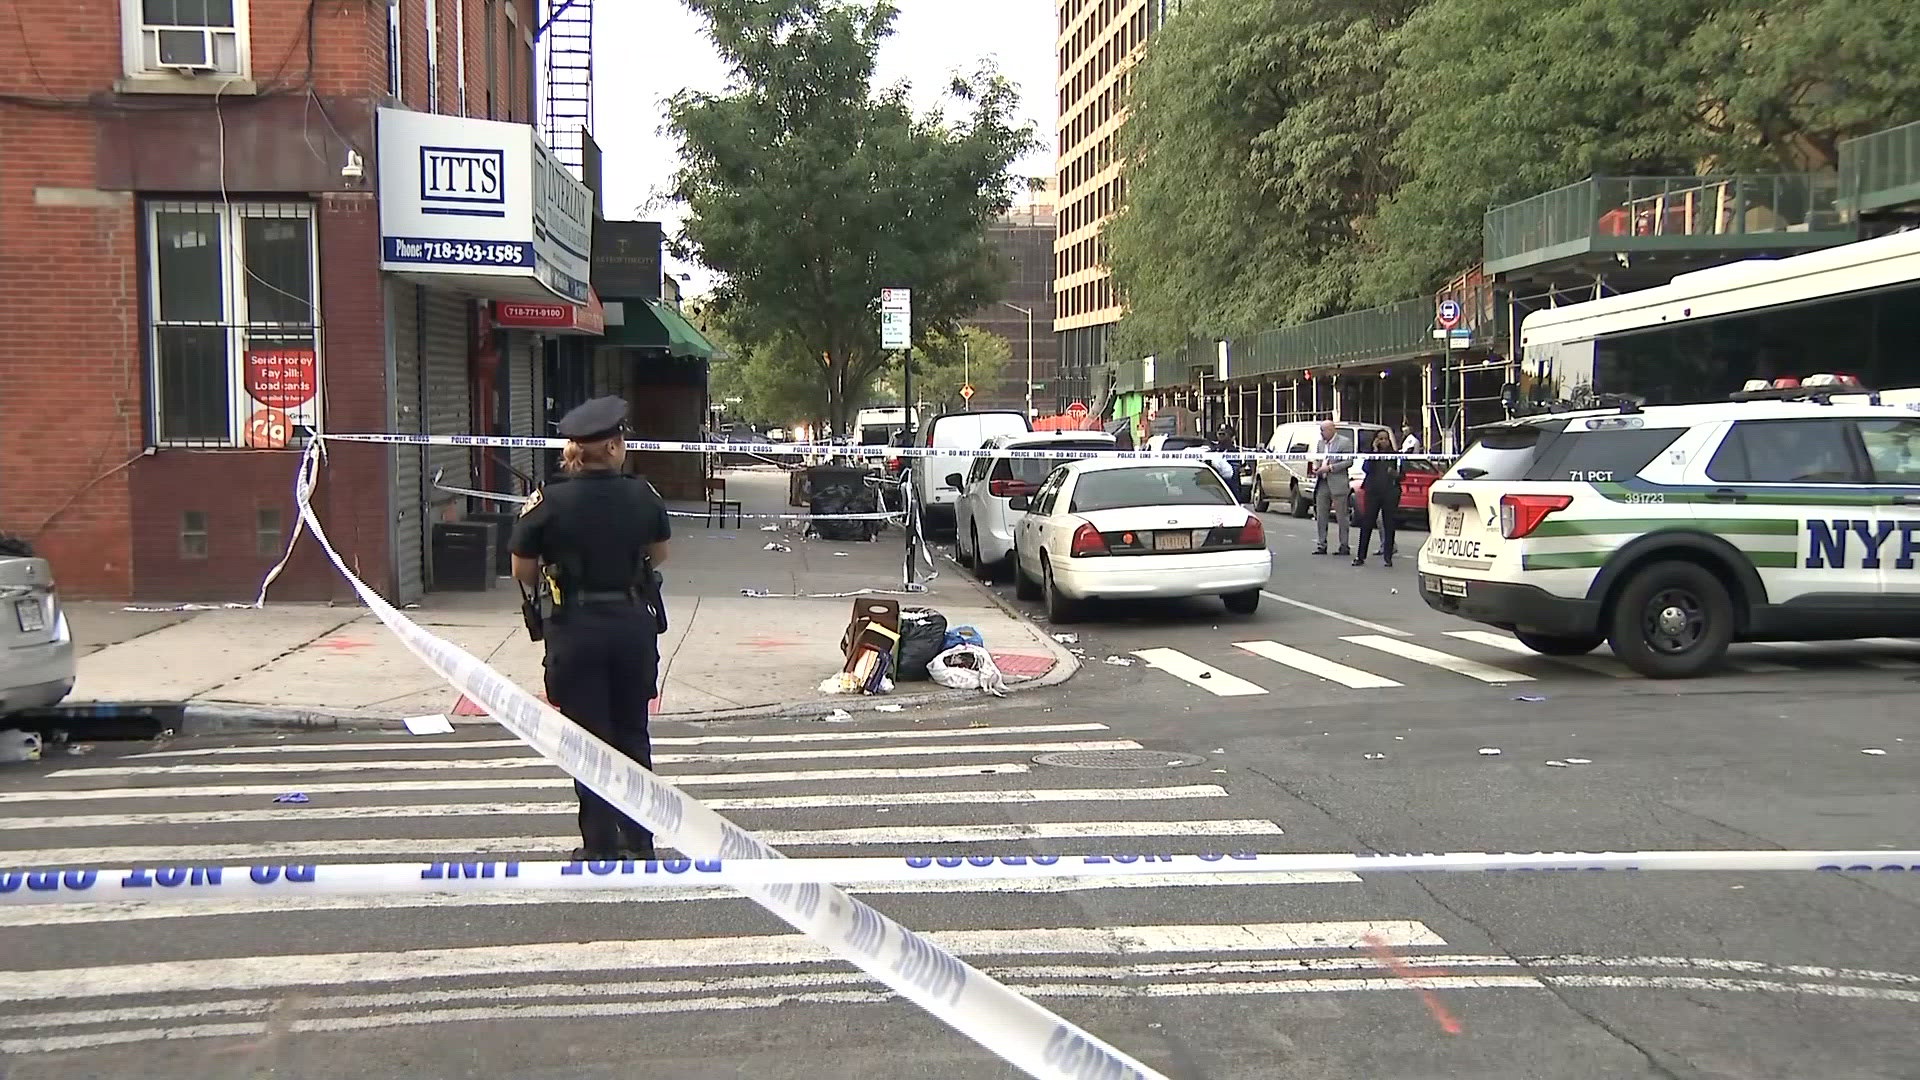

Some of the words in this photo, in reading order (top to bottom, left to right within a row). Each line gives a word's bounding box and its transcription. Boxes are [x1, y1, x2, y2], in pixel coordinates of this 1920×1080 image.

[430, 155, 497, 193] ITTS
[396, 239, 423, 258] Phone:
[424, 242, 523, 264] 718-363-1585
[509, 308, 561, 317] 718-771-9100
[251, 355, 277, 365] Send
[255, 382, 280, 391] Load
[252, 414, 285, 440] ria
[451, 436, 472, 444] POLICE
[476, 437, 489, 445] LINE
[500, 438, 509, 446] DO
[511, 438, 524, 446] NOT
[526, 438, 546, 447] CROSS
[681, 443, 701, 451] POLICE
[753, 445, 773, 453] CROSS
[793, 446, 812, 454] POLICE
[850, 447, 862, 455] NOT
[1569, 471, 1583, 481] 71
[1588, 471, 1613, 482] PCT
[1624, 493, 1664, 504] 391723
[1447, 539, 1481, 558] POLICE
